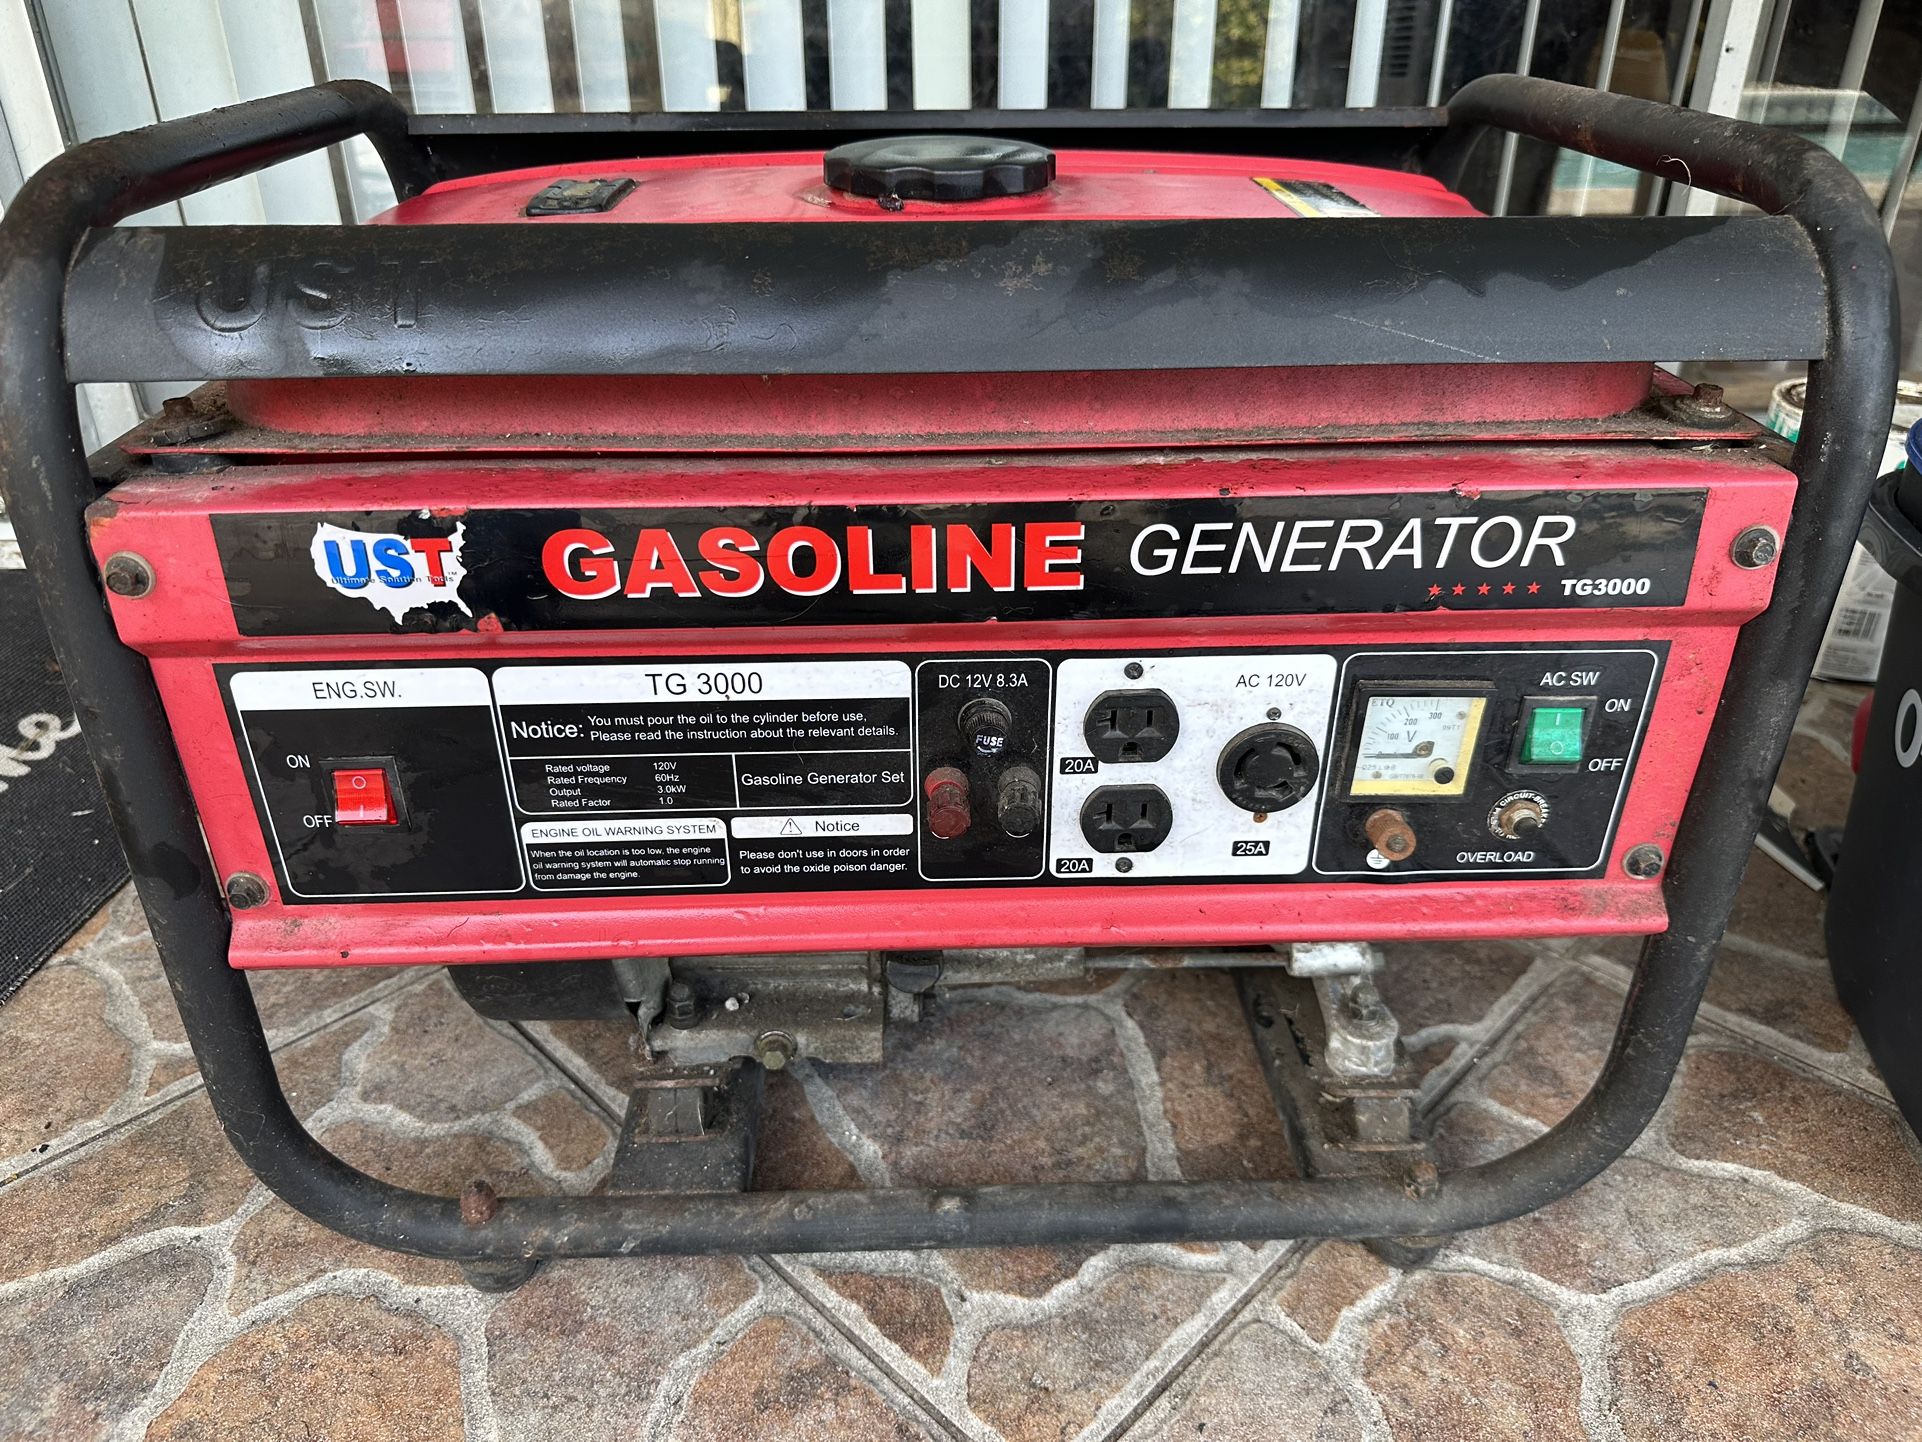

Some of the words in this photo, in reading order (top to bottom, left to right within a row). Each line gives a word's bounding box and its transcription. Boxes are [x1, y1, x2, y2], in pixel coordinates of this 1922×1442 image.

[323, 537, 453, 589] UST
[541, 521, 1086, 600] GASOLINE
[1129, 514, 1577, 576] GENERATOR
[1560, 577, 1651, 596] TG3000
[645, 673, 687, 695] TG
[697, 672, 762, 695] 3000
[938, 674, 960, 688] DC
[965, 674, 993, 688] 12V
[996, 673, 1028, 687] 8.3A
[1235, 674, 1260, 688] AC
[1267, 673, 1307, 687] 120V
[1539, 672, 1567, 686] AC
[1569, 672, 1600, 686] SW
[312, 680, 402, 700] ENG.SW.
[1604, 699, 1631, 712] ON
[588, 715, 611, 726] You
[615, 716, 644, 726] must
[648, 716, 674, 727] pour
[678, 714, 696, 724] the
[700, 713, 713, 724] oil
[716, 714, 727, 724] to
[731, 713, 750, 723] the
[753, 712, 798, 725] cylinder
[801, 711, 839, 722] before
[842, 713, 867, 722] use,
[1404, 718, 1418, 726] 200
[1428, 712, 1443, 720] 300
[510, 721, 584, 739] Notice:
[590, 731, 632, 741] Please
[635, 730, 661, 740] read
[665, 730, 683, 740] the
[687, 728, 747, 739] instruction
[750, 728, 783, 738] about
[786, 727, 805, 737] the
[808, 726, 854, 737] relevant
[857, 725, 899, 736] details.
[1407, 730, 1417, 742] V
[975, 734, 1004, 747] FUSE
[286, 754, 311, 769] ON
[545, 764, 573, 773] Rated
[576, 764, 610, 774] voltage
[653, 762, 677, 771] 120V
[1065, 759, 1095, 772] 20A
[1588, 758, 1623, 771] OFF
[547, 776, 576, 785] Rated
[578, 775, 627, 785] Frequency
[655, 773, 680, 782] 60Hz
[741, 773, 803, 786] Gasoline
[807, 772, 877, 784] Generator
[881, 770, 905, 784] Set
[549, 788, 582, 797] Output
[657, 785, 687, 794] 3.0kW
[551, 799, 579, 808] Rated
[581, 799, 611, 807] Factor
[659, 797, 674, 805] 1.0
[302, 815, 333, 829] OFF
[815, 820, 860, 832] Notice
[531, 828, 578, 838] ENGINE
[582, 827, 602, 837] OIL
[605, 825, 664, 836] WARNING
[666, 824, 717, 835] SYSTEM
[530, 849, 557, 858] When
[558, 849, 573, 858] the
[574, 848, 585, 857] oil
[586, 847, 620, 857] location
[622, 847, 630, 855] is
[631, 847, 646, 855] too
[666, 846, 680, 855] the
[682, 846, 711, 856] engine
[739, 850, 775, 860] Please
[777, 849, 803, 859] don't
[805, 850, 824, 858] use
[827, 849, 837, 858] in
[839, 848, 868, 857] doors
[870, 848, 881, 857] in
[883, 847, 910, 857] order
[1236, 842, 1267, 855] 25A
[532, 861, 544, 869] oil
[544, 860, 579, 870] warning
[581, 860, 612, 870] system
[613, 858, 628, 867] will
[629, 858, 671, 867] automatic
[672, 858, 692, 868] stop
[693, 857, 725, 867] running
[1456, 851, 1535, 863] OVERLOAD
[740, 865, 751, 874] to
[753, 864, 781, 873] avoid
[784, 864, 800, 873] the
[803, 863, 830, 872] oxide
[833, 863, 867, 874] poison
[870, 862, 908, 873] danger.
[1060, 860, 1090, 872] 20A
[534, 872, 555, 881] from
[556, 872, 592, 882] damage
[593, 871, 608, 880] the
[609, 871, 641, 881] engine.
